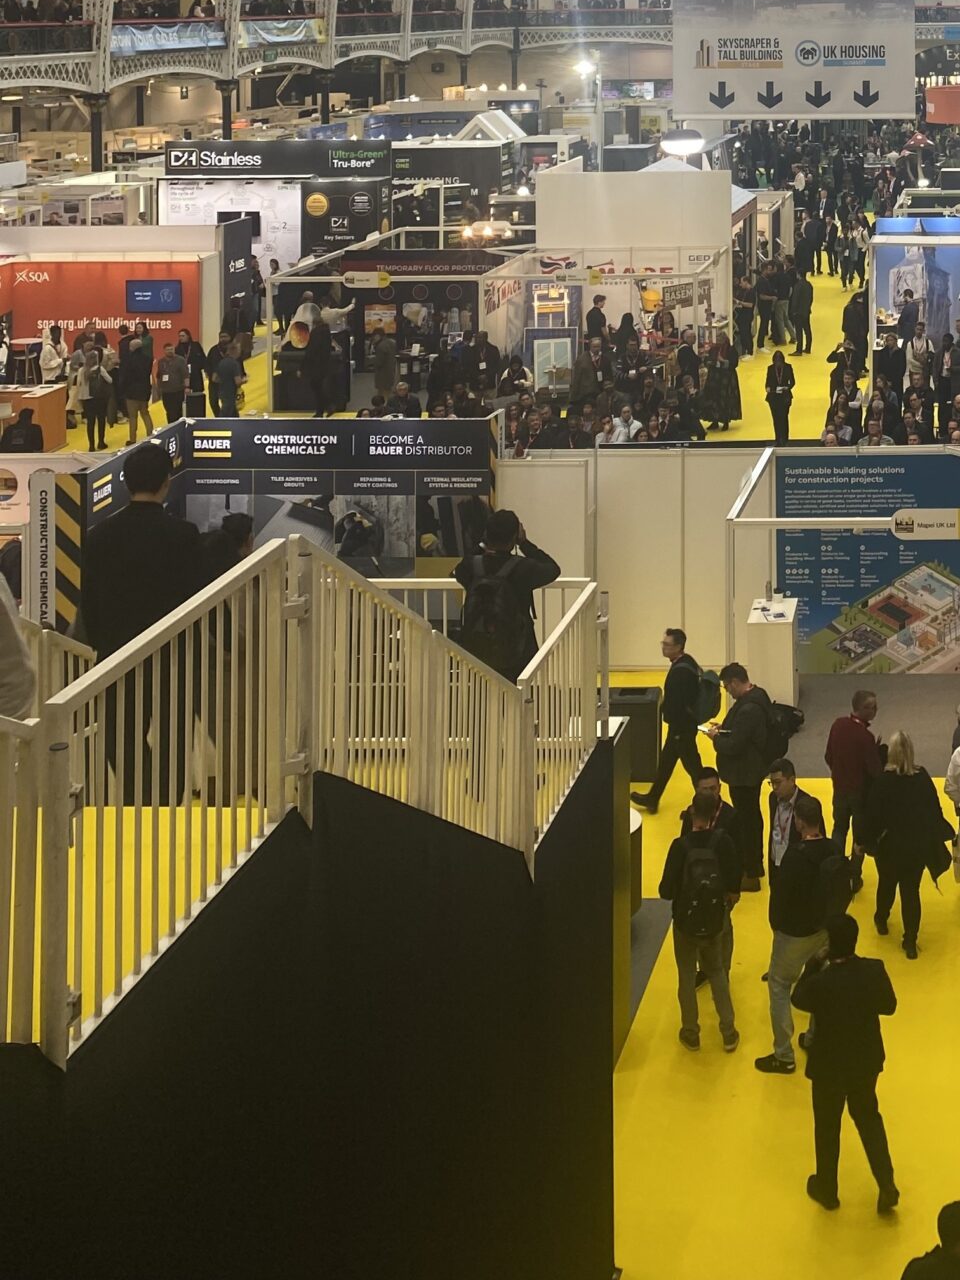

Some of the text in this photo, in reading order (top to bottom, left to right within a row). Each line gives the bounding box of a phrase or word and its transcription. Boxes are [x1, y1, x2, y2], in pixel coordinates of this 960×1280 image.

[717, 38, 780, 49] SKYSCRAPER &
[717, 50, 783, 60] TALL BUILDINGS
[823, 44, 886, 58] UK HOUSING
[200, 150, 262, 166] Stainless
[324, 234, 334, 242] Key
[452, 264, 496, 272] PROTECTIO
[29, 272, 50, 283] SQA
[665, 286, 709, 301] BASEMNT
[194, 439, 231, 449] BAUER
[254, 435, 338, 445] CONSTRUCTION
[369, 436, 424, 445] BECOME A
[265, 446, 326, 454] CHEMICALS
[369, 446, 472, 455] BAUER DISTRIBUTOR
[784, 466, 905, 476] Sustainable building solutions
[784, 476, 884, 484] for construction projects
[40, 490, 48, 568] CONSTRUCTION
[917, 522, 934, 530] Mapei
